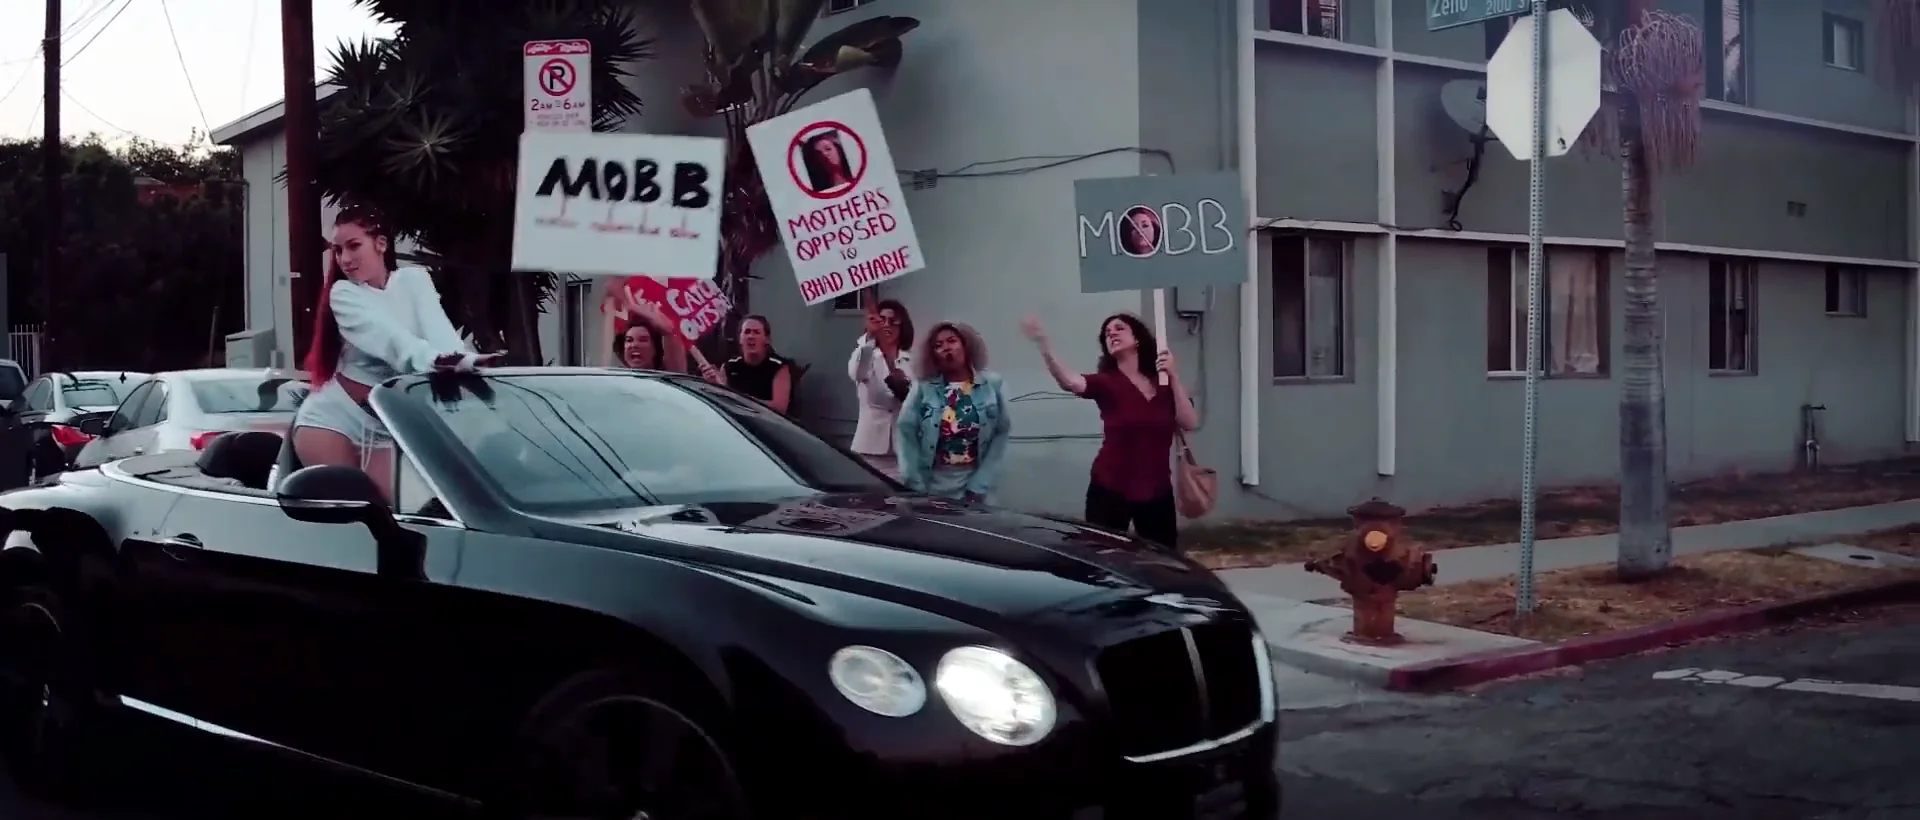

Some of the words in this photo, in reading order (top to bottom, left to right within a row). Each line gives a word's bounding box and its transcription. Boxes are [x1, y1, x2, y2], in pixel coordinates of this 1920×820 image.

[1430, 0, 1469, 18] Zeno
[535, 157, 711, 209] MOBB
[787, 187, 890, 239] MOTHERS
[796, 212, 897, 261] OPPOSED
[1079, 197, 1234, 258] MOBB
[800, 271, 844, 302] BHAD
[847, 245, 909, 287] BHABIE
[680, 292, 733, 340] OUTS
